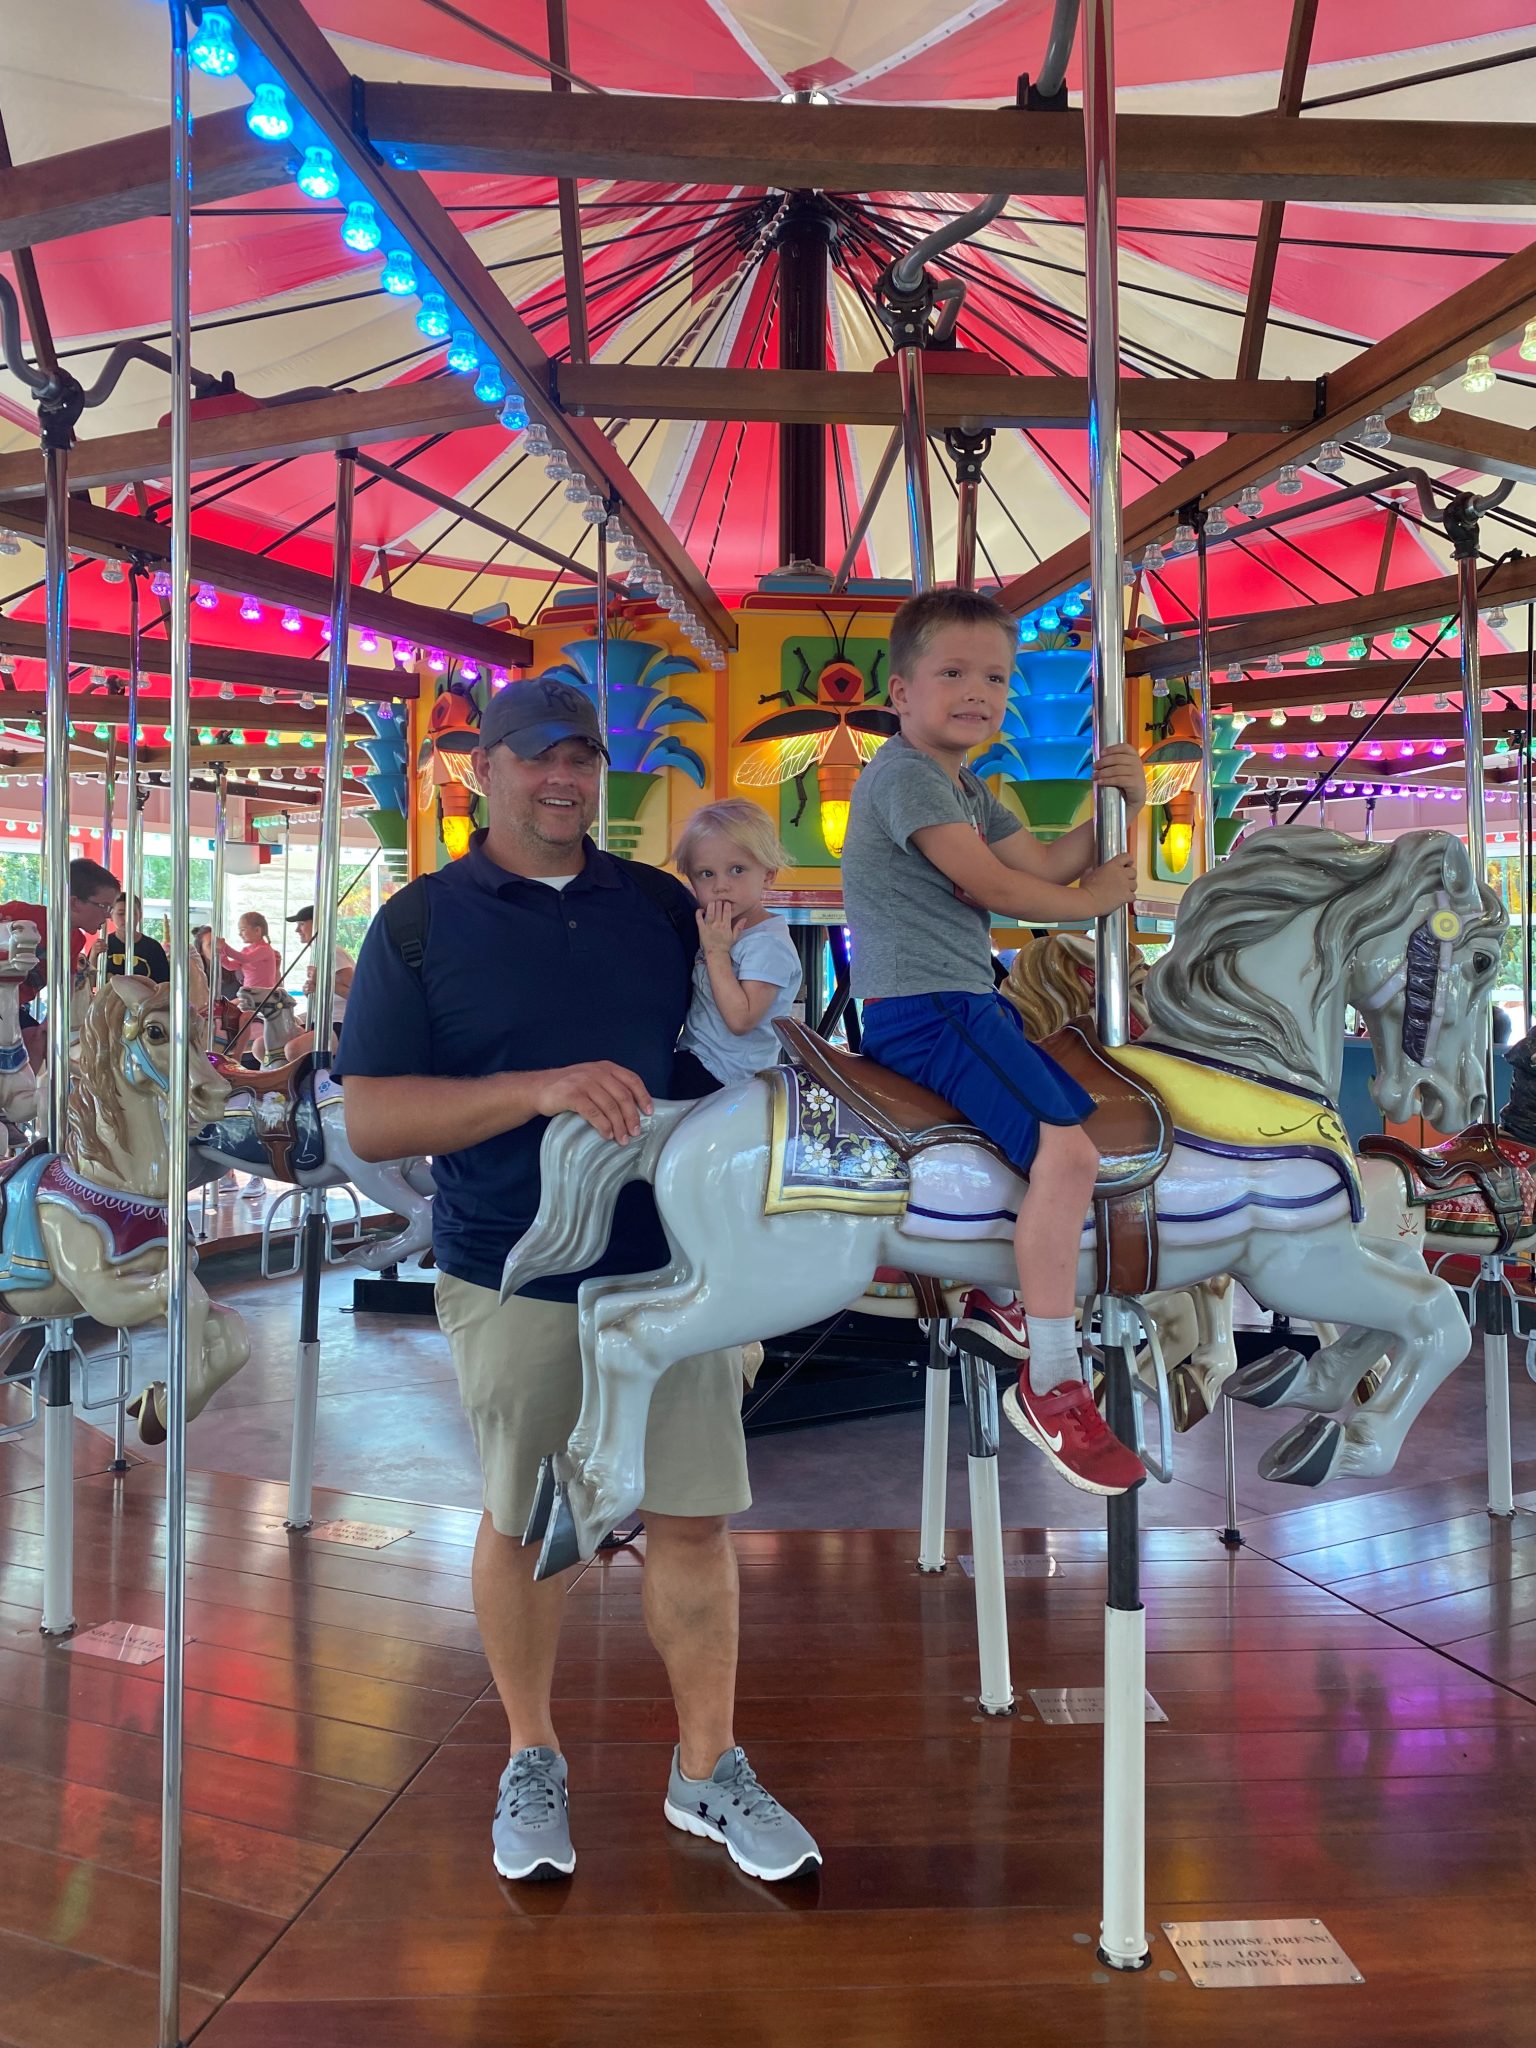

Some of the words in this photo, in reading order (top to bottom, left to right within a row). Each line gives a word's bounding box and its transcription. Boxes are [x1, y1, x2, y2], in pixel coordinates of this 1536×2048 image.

[109, 1633, 165, 1649] LANCELO
[1175, 1939, 1210, 1947] OUR
[1212, 1937, 1271, 1947] HORSE,
[1237, 1949, 1288, 1959] LOVE,
[1191, 1960, 1223, 1969] LES
[1226, 1959, 1258, 1968] AND
[1261, 1958, 1293, 1967] KAY
[1296, 1956, 1343, 1966] HOLE
